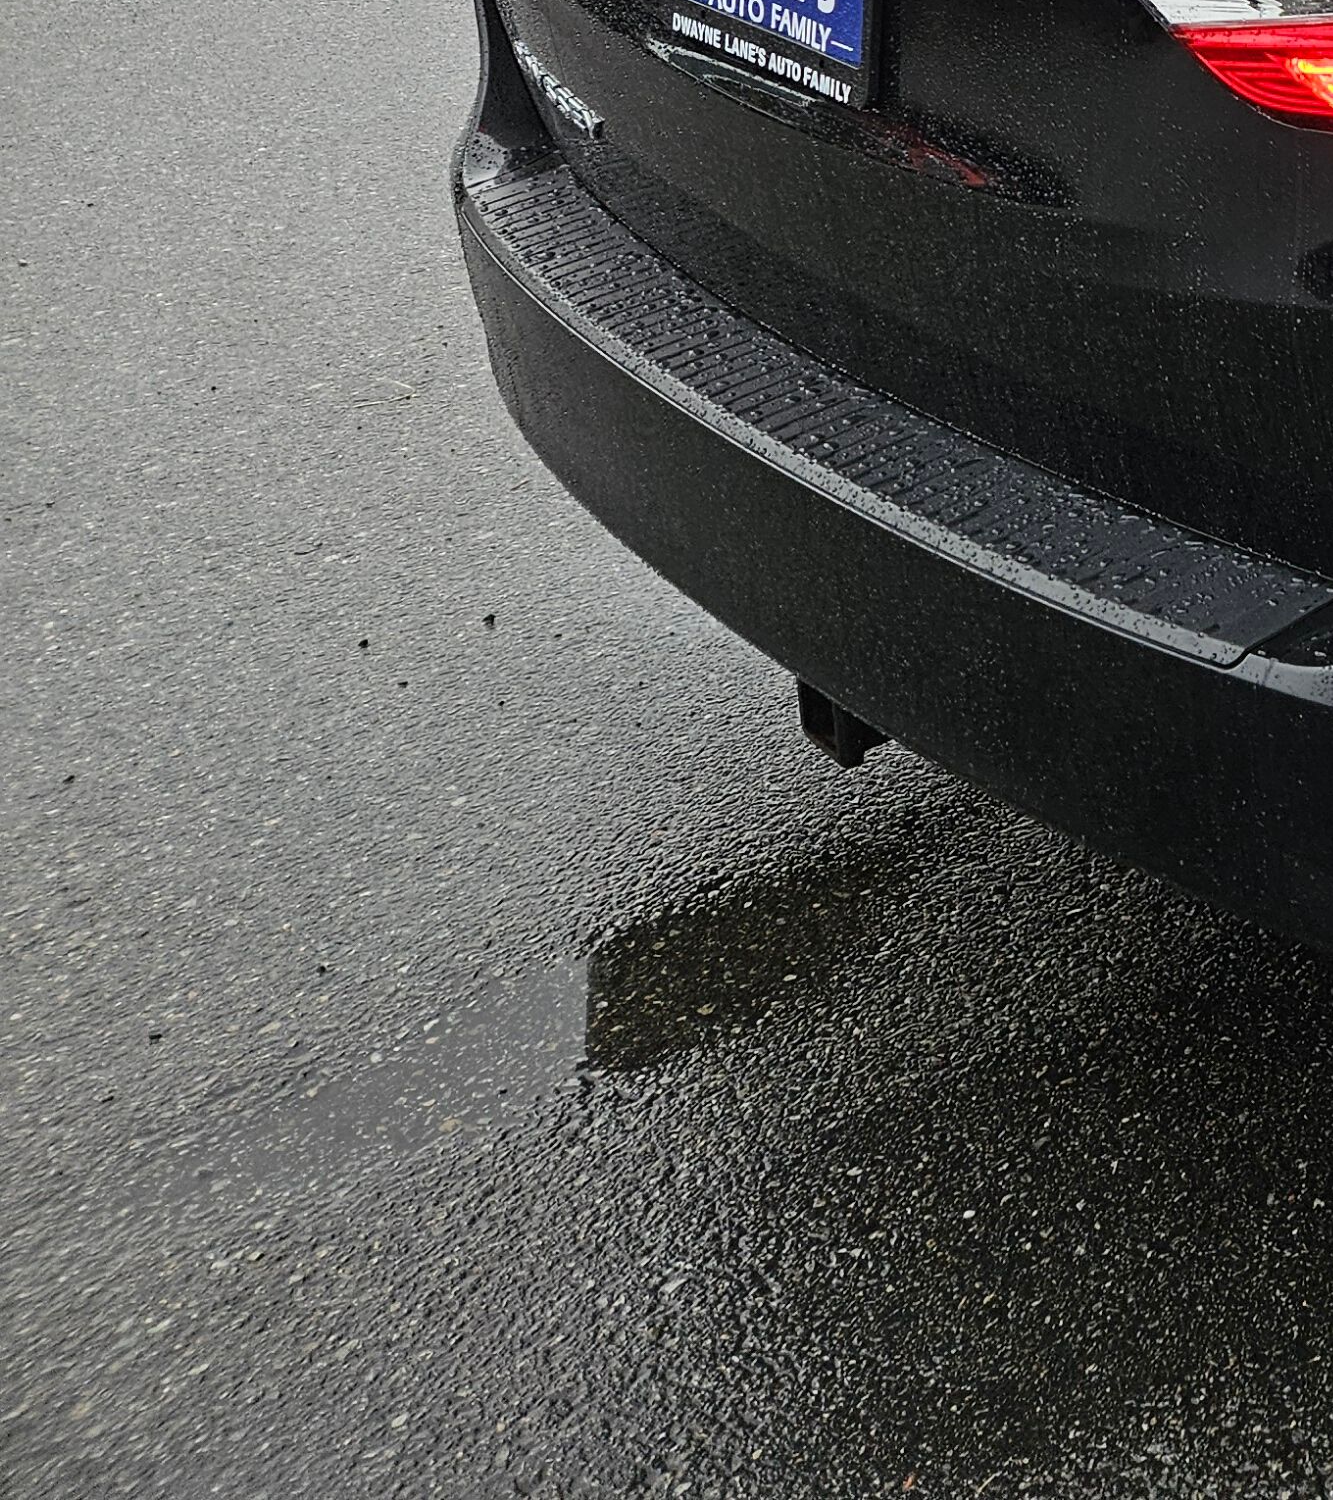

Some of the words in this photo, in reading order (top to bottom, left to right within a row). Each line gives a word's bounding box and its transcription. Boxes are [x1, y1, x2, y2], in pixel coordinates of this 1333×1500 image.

[672, 12, 722, 49] DWAYNE
[724, 33, 767, 67] LANE'S
[767, 53, 802, 82] AUTO
[803, 68, 851, 104] FAMILY
[770, 5, 832, 52] FAMILY
